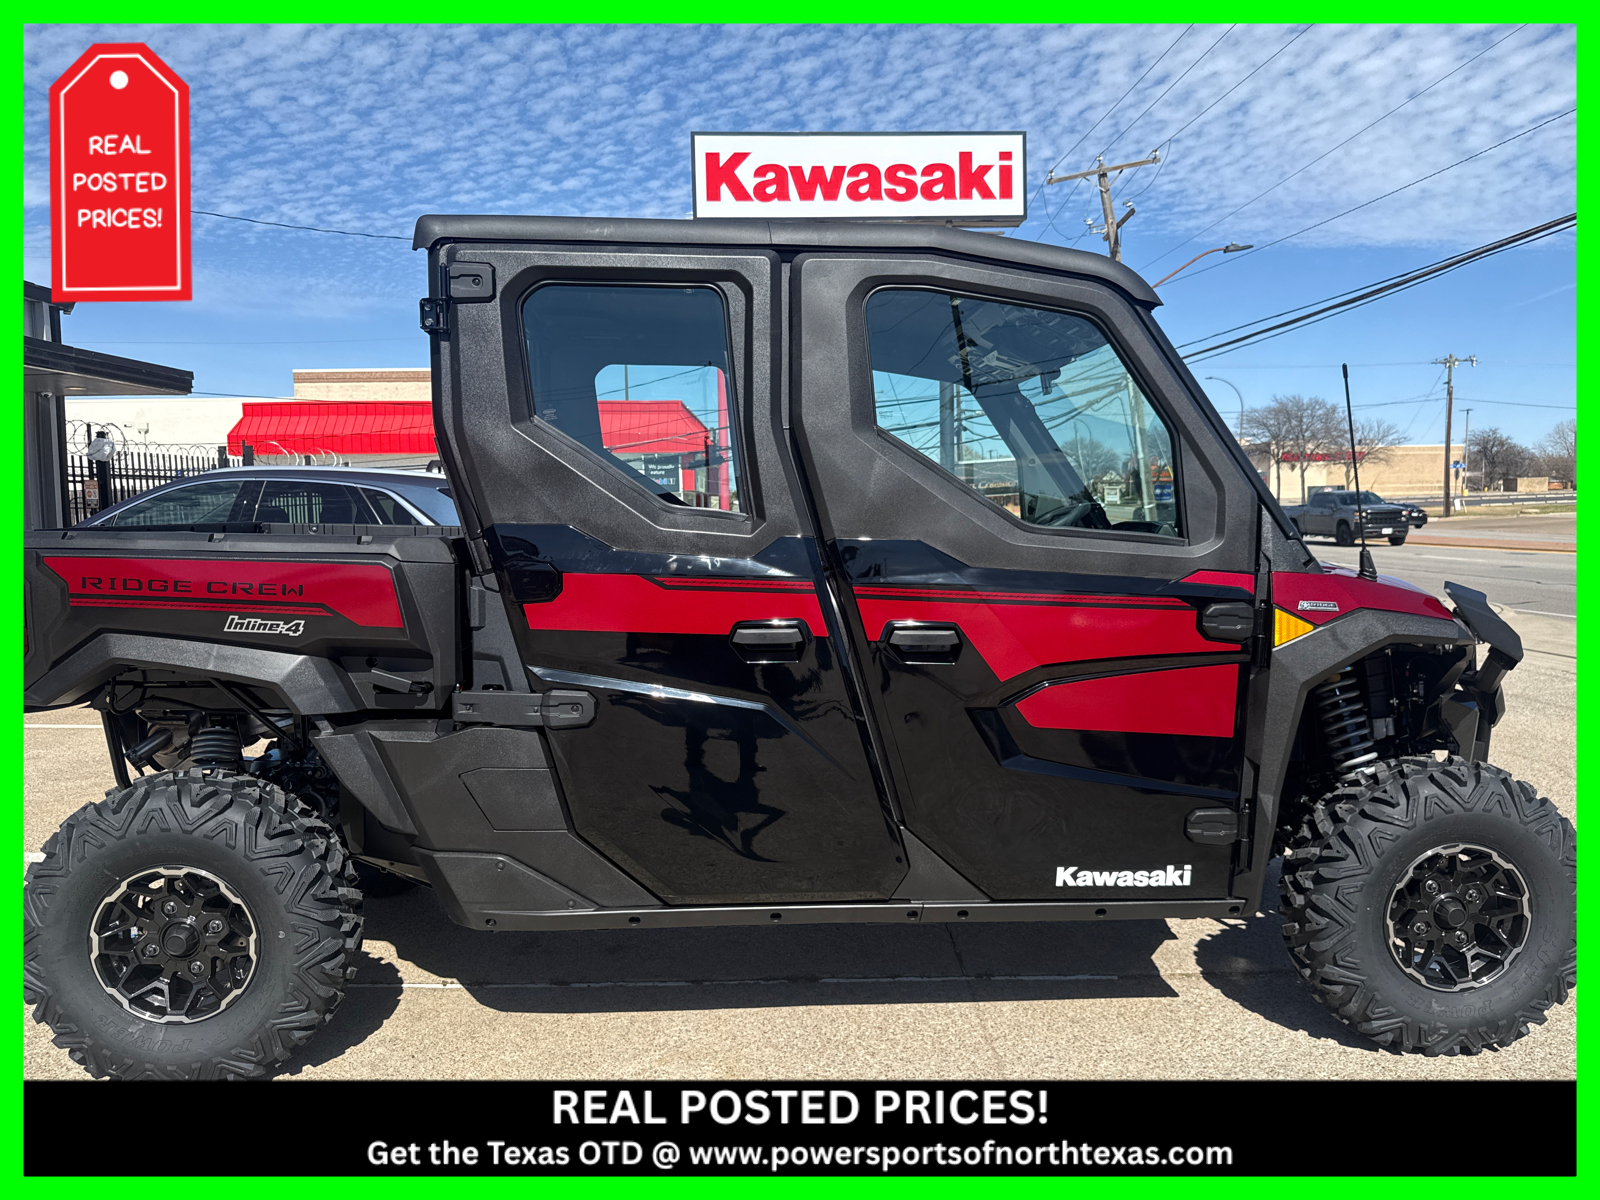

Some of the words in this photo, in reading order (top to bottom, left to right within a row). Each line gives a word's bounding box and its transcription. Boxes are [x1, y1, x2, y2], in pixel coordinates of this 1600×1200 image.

[705, 151, 1013, 203] Kawasaki
[81, 576, 193, 593] RIDGE
[206, 581, 304, 597] CREW
[223, 615, 306, 637] Inline-4
[1055, 864, 1192, 888] Kawasaki
[1405, 993, 1494, 1019] POWER
[93, 1014, 193, 1054] POWER
